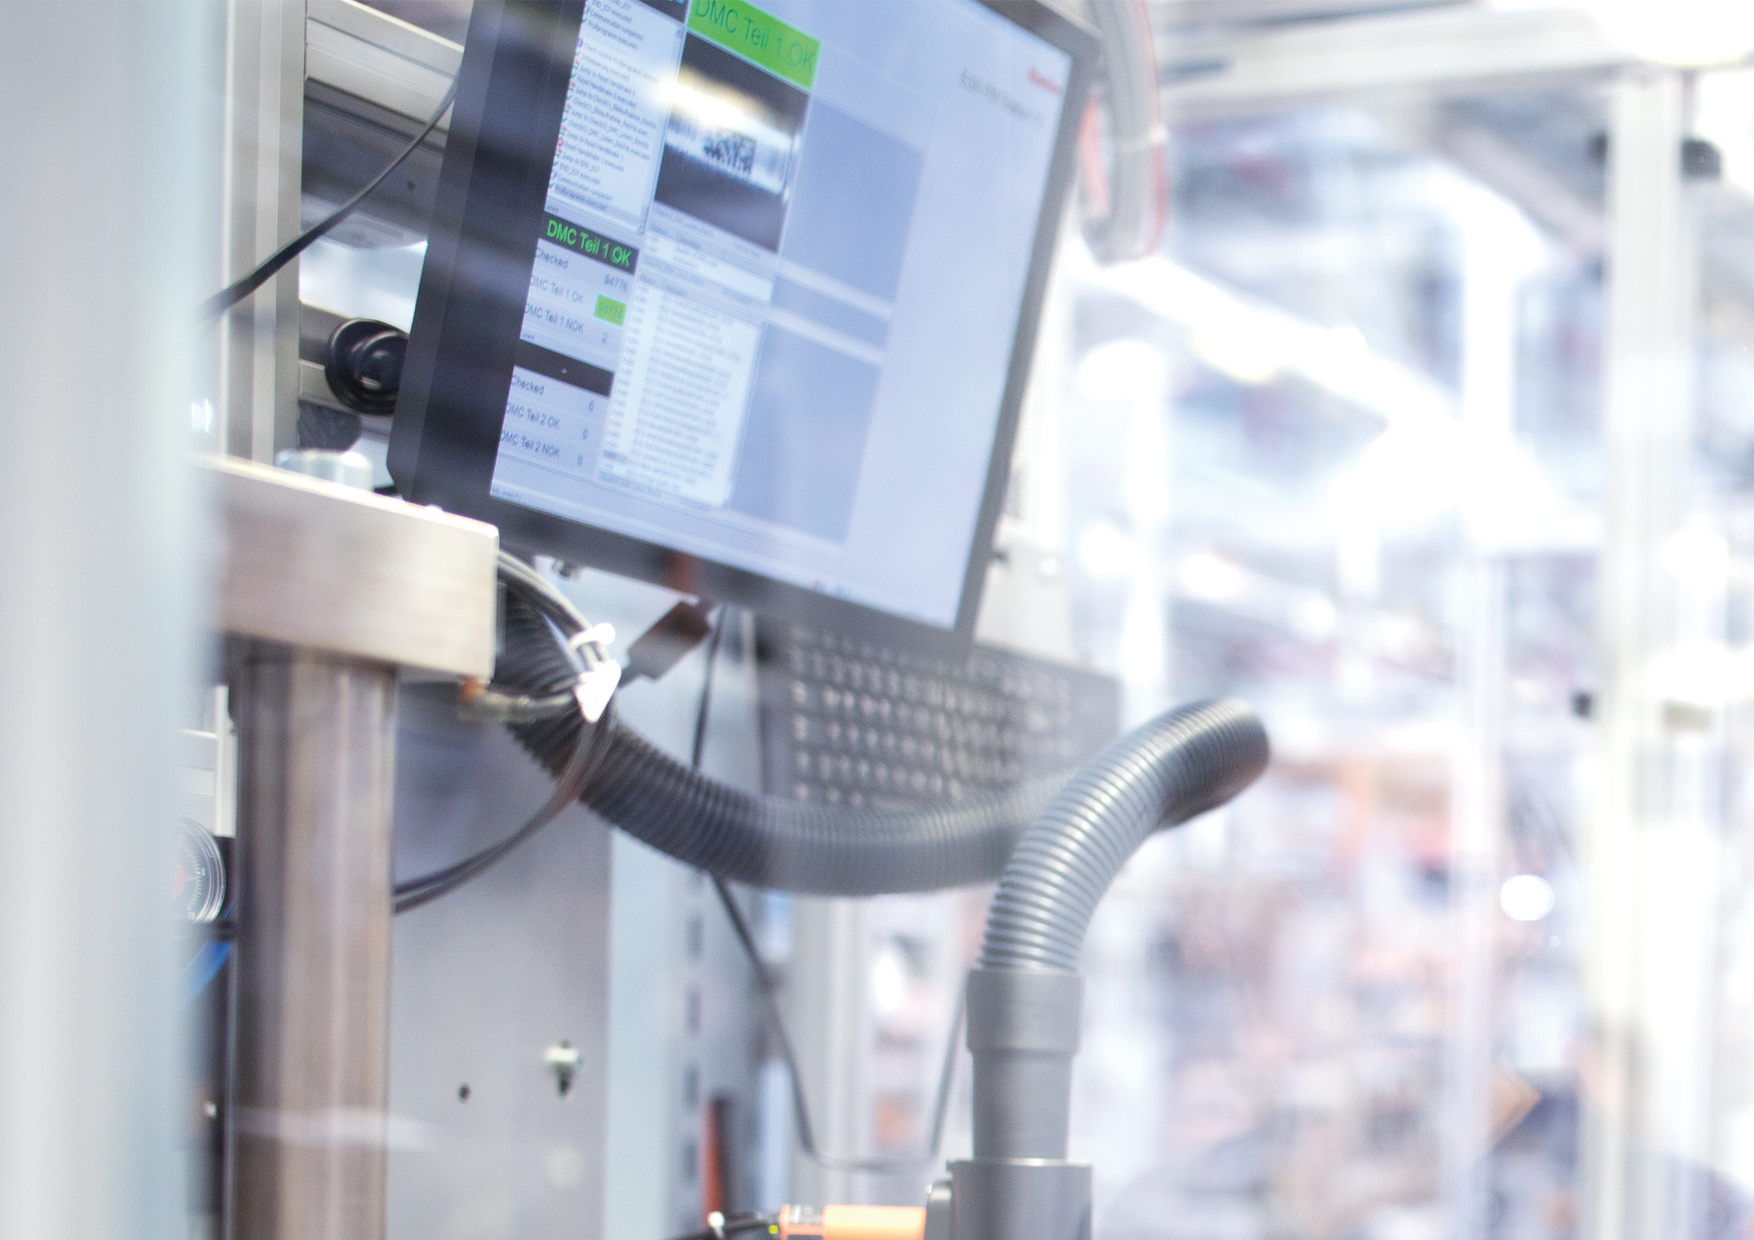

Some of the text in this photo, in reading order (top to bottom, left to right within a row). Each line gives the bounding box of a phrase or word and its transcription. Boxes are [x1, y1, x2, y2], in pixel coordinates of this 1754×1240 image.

[695, 0, 817, 74] DMC Teil 1 OK
[546, 219, 577, 246] DMC
[580, 231, 601, 256] Teil
[603, 242, 610, 259] 1
[611, 246, 632, 268] OK
[535, 248, 569, 269] Checked
[529, 275, 549, 291] DMC
[550, 282, 564, 297] Teil
[572, 290, 585, 305] OK
[525, 303, 543, 319] DMC
[545, 309, 559, 323] Teil
[566, 317, 585, 335] NOK
[511, 374, 545, 395] Checked
[505, 402, 561, 430] DMC Teil 2 OK
[500, 430, 561, 459] DMC Teil 2 NOK
